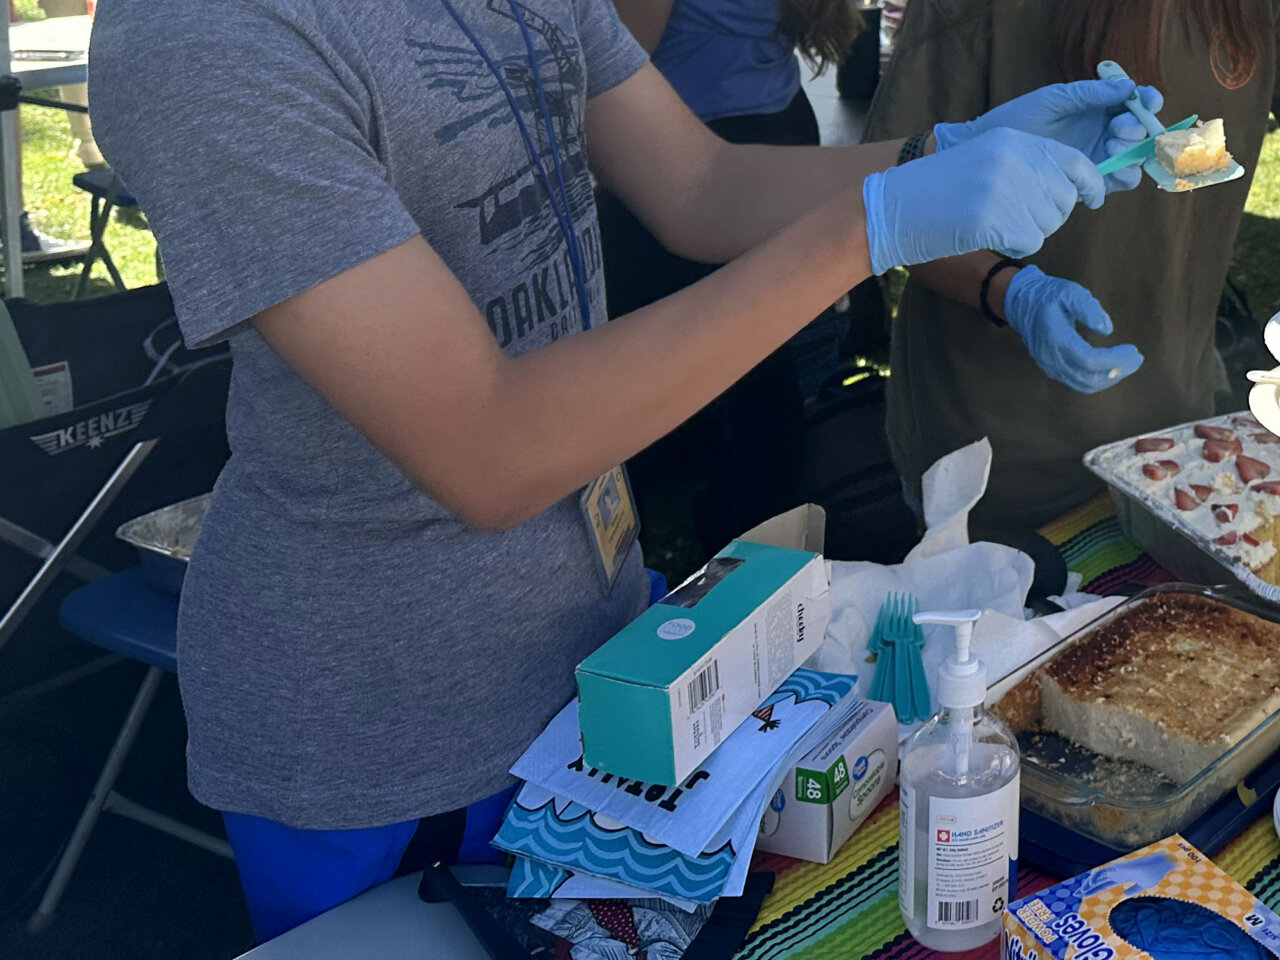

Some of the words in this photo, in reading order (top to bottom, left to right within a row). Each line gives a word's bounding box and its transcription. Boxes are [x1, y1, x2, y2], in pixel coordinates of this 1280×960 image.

[58, 408, 130, 447] KEENZ
[797, 603, 805, 643] cheeky
[833, 762, 846, 783] 48
[807, 778, 822, 800] 48
[951, 830, 972, 838] HAND
[973, 819, 1004, 836] SANITIZER
[1186, 852, 1202, 863] 100
[1029, 899, 1054, 922] FREE
[1244, 914, 1263, 927] M
[1017, 906, 1057, 943] POWDER
[1054, 914, 1114, 960] Gloves
